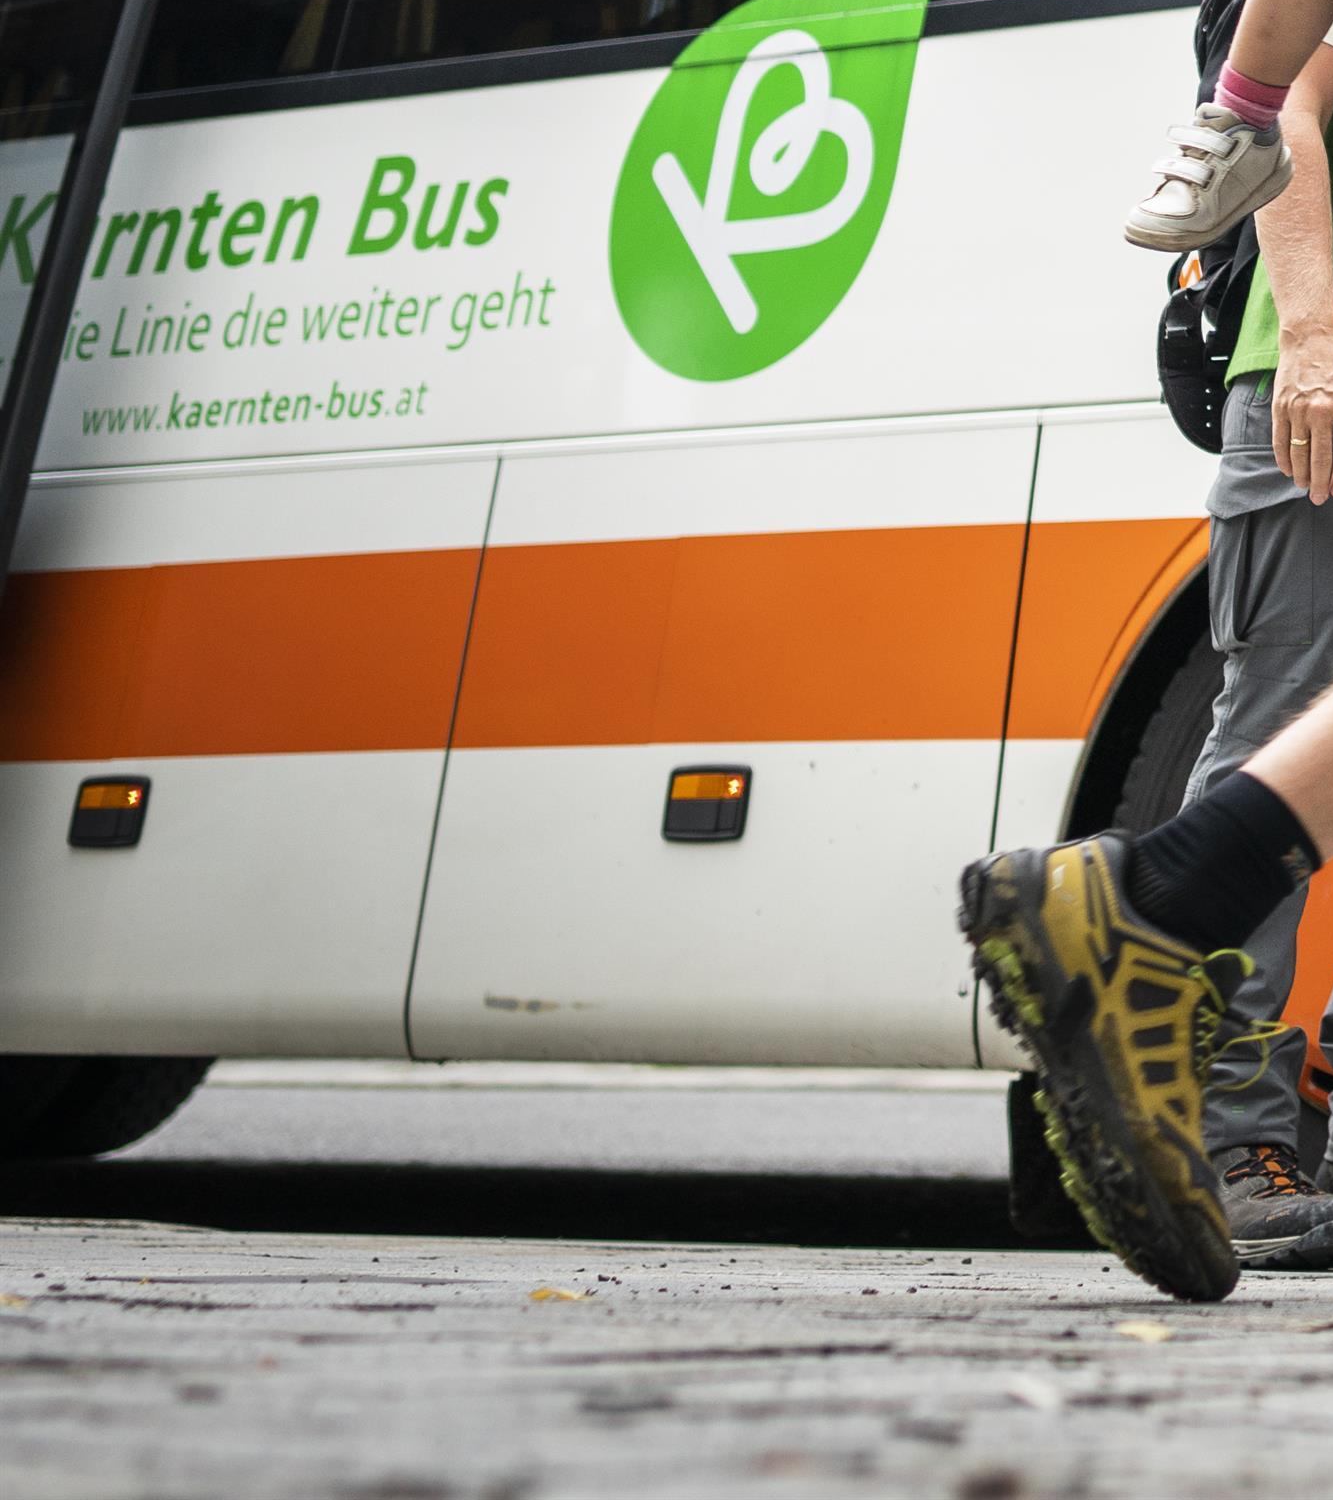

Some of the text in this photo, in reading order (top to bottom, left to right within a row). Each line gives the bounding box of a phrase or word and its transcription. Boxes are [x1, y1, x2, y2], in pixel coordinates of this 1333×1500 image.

[0, 154, 511, 287] Krnten Bus
[109, 300, 211, 358] Linie
[222, 291, 288, 350] die
[302, 285, 443, 342] weiter
[445, 270, 558, 352] geht
[81, 380, 430, 437] www.kaernten-bus.at
